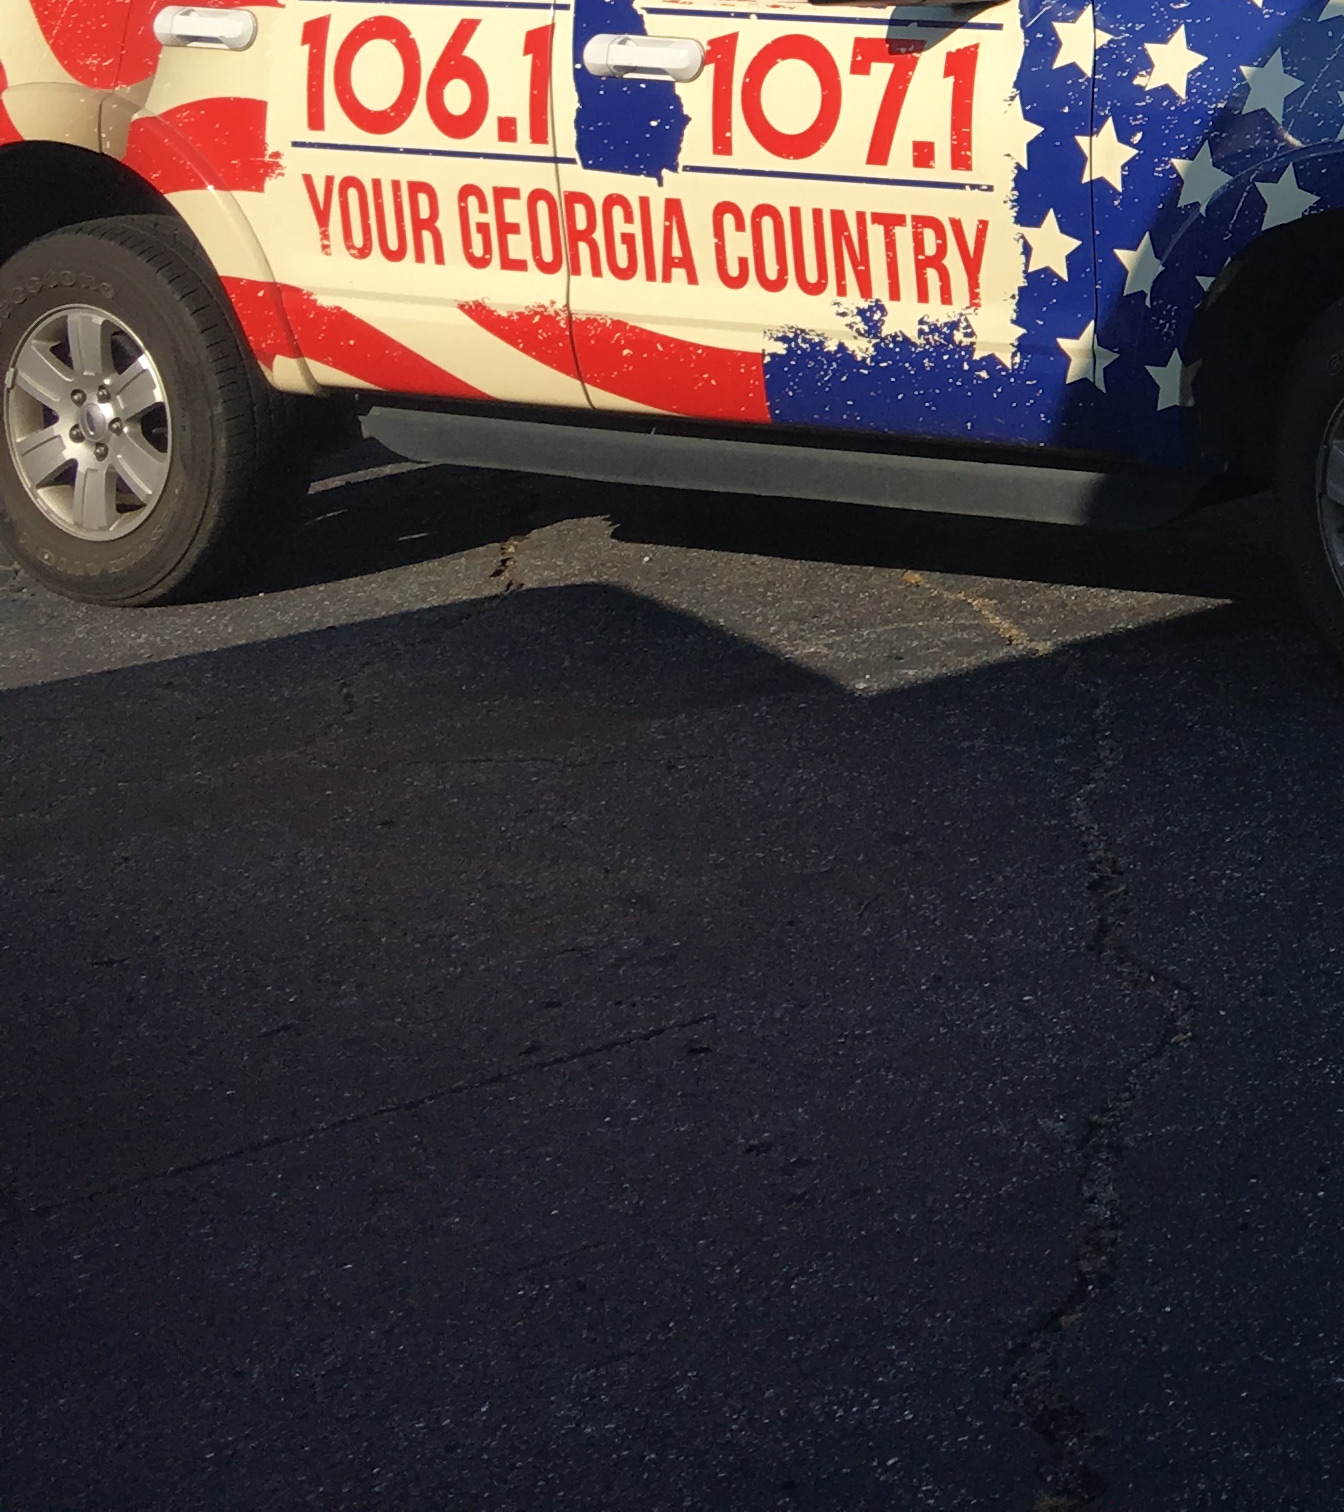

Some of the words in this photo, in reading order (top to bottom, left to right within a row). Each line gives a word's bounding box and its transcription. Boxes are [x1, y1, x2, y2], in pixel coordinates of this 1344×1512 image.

[300, 13, 556, 145] 106.1
[702, 30, 980, 172] 107.1
[302, 173, 445, 265] YOUR
[457, 182, 699, 286] GEORGIA
[712, 200, 989, 309] COUNTRY
